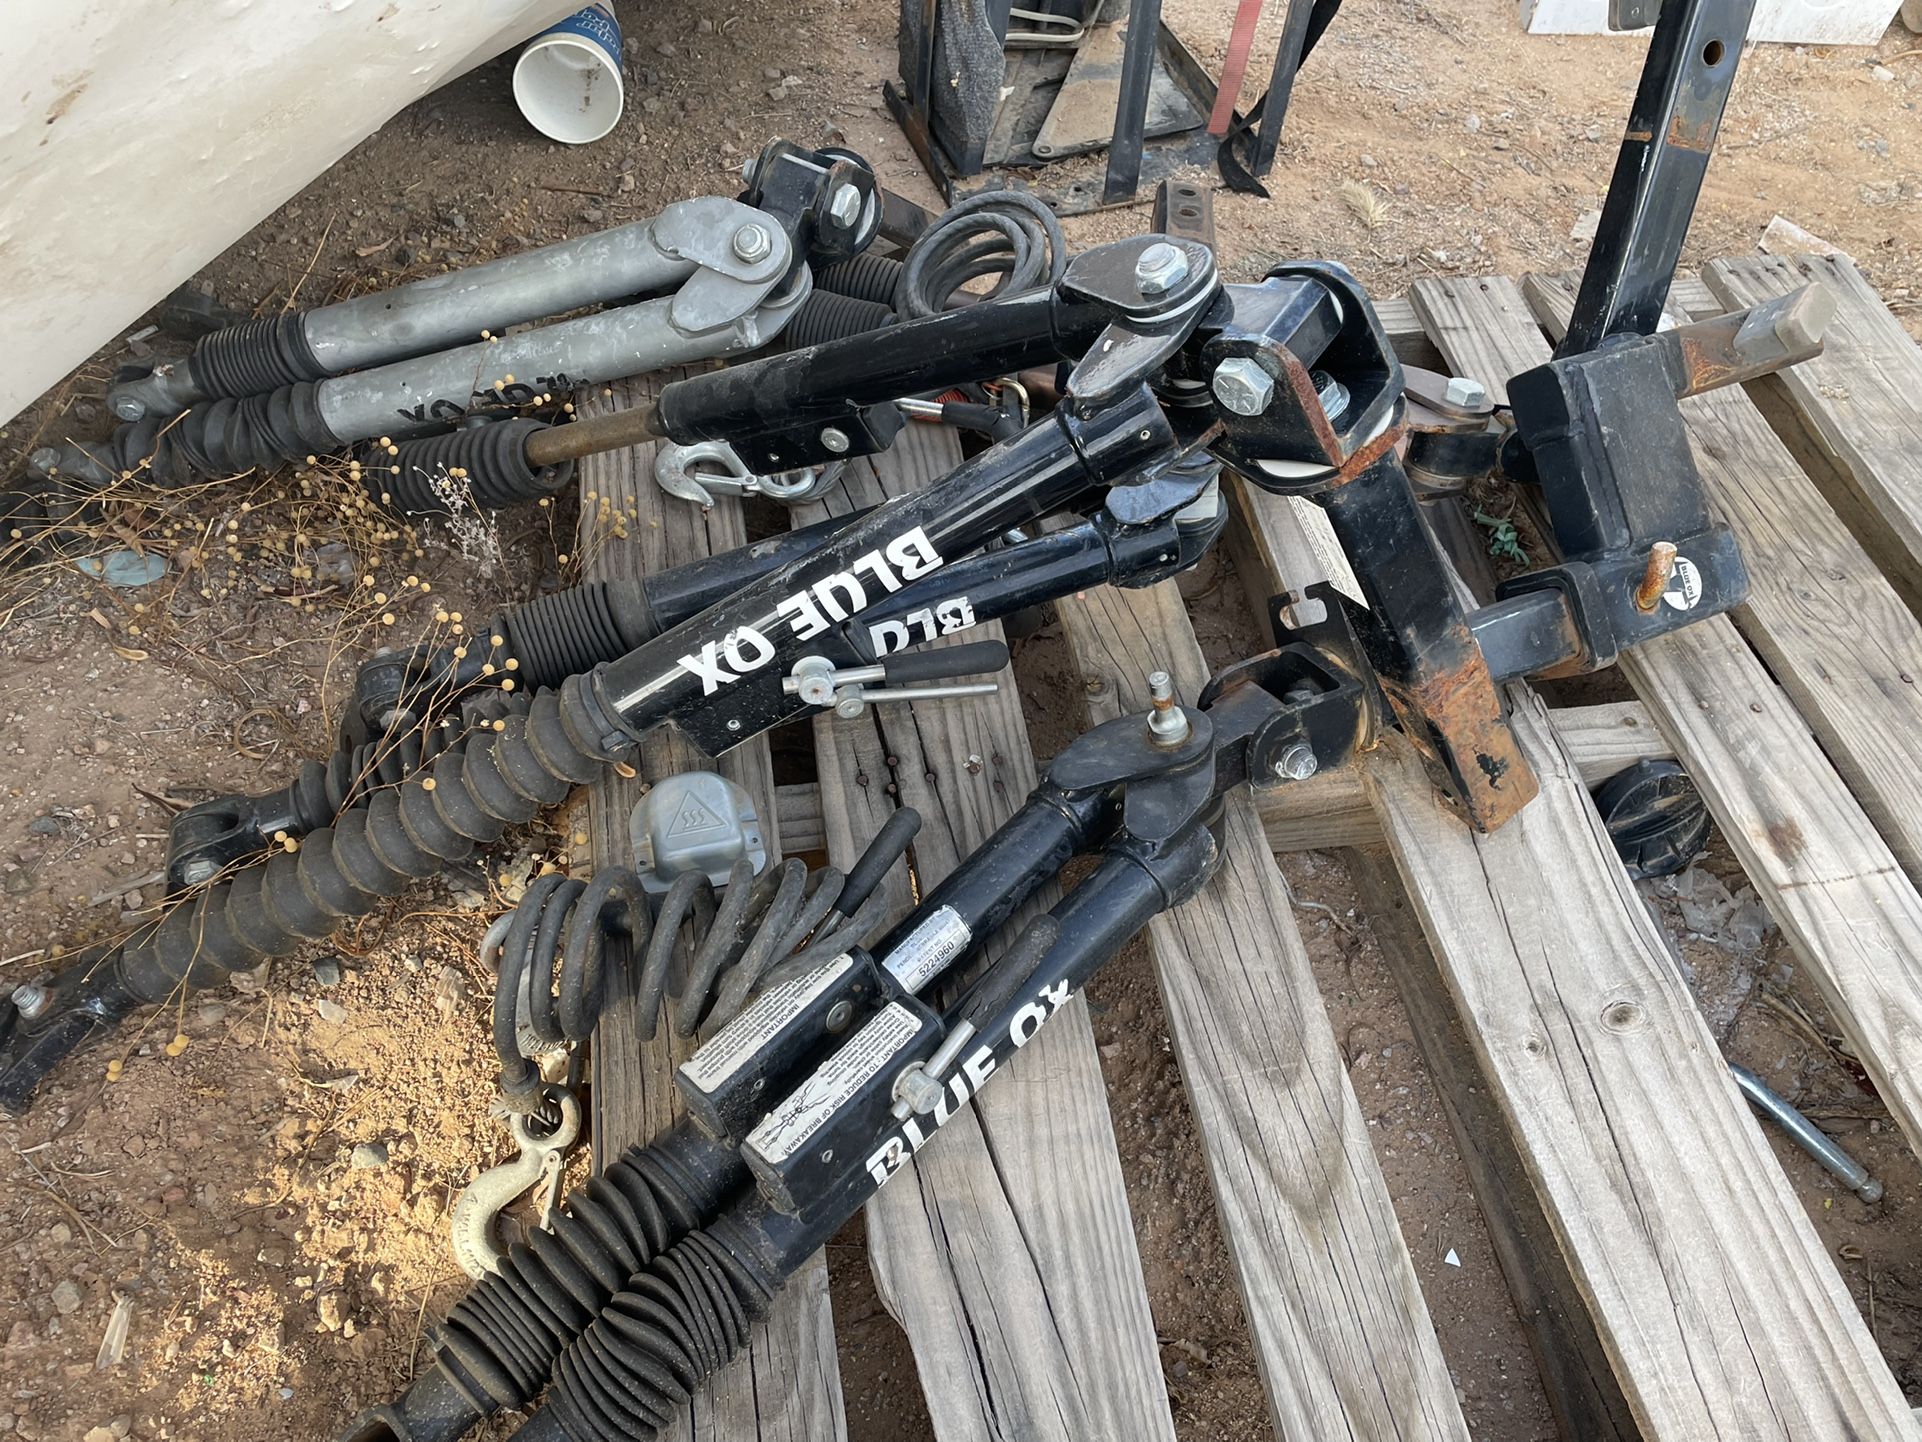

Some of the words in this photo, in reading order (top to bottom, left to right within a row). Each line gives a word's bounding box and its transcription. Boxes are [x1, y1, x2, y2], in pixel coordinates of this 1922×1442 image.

[775, 526, 944, 641] BLUE
[1680, 565, 1691, 584] BLUE
[1686, 584, 1694, 595] OX
[677, 625, 776, 696] OX
[916, 940, 956, 977] 5224960
[759, 1002, 799, 1040] IMPORTANT
[1008, 978, 1075, 1048] OX
[880, 1028, 914, 1060] IMPORTANT
[843, 1070, 870, 1096] REDUCE
[867, 1062, 879, 1073] TO
[819, 1108, 830, 1119] OF
[829, 1094, 845, 1110] RISK
